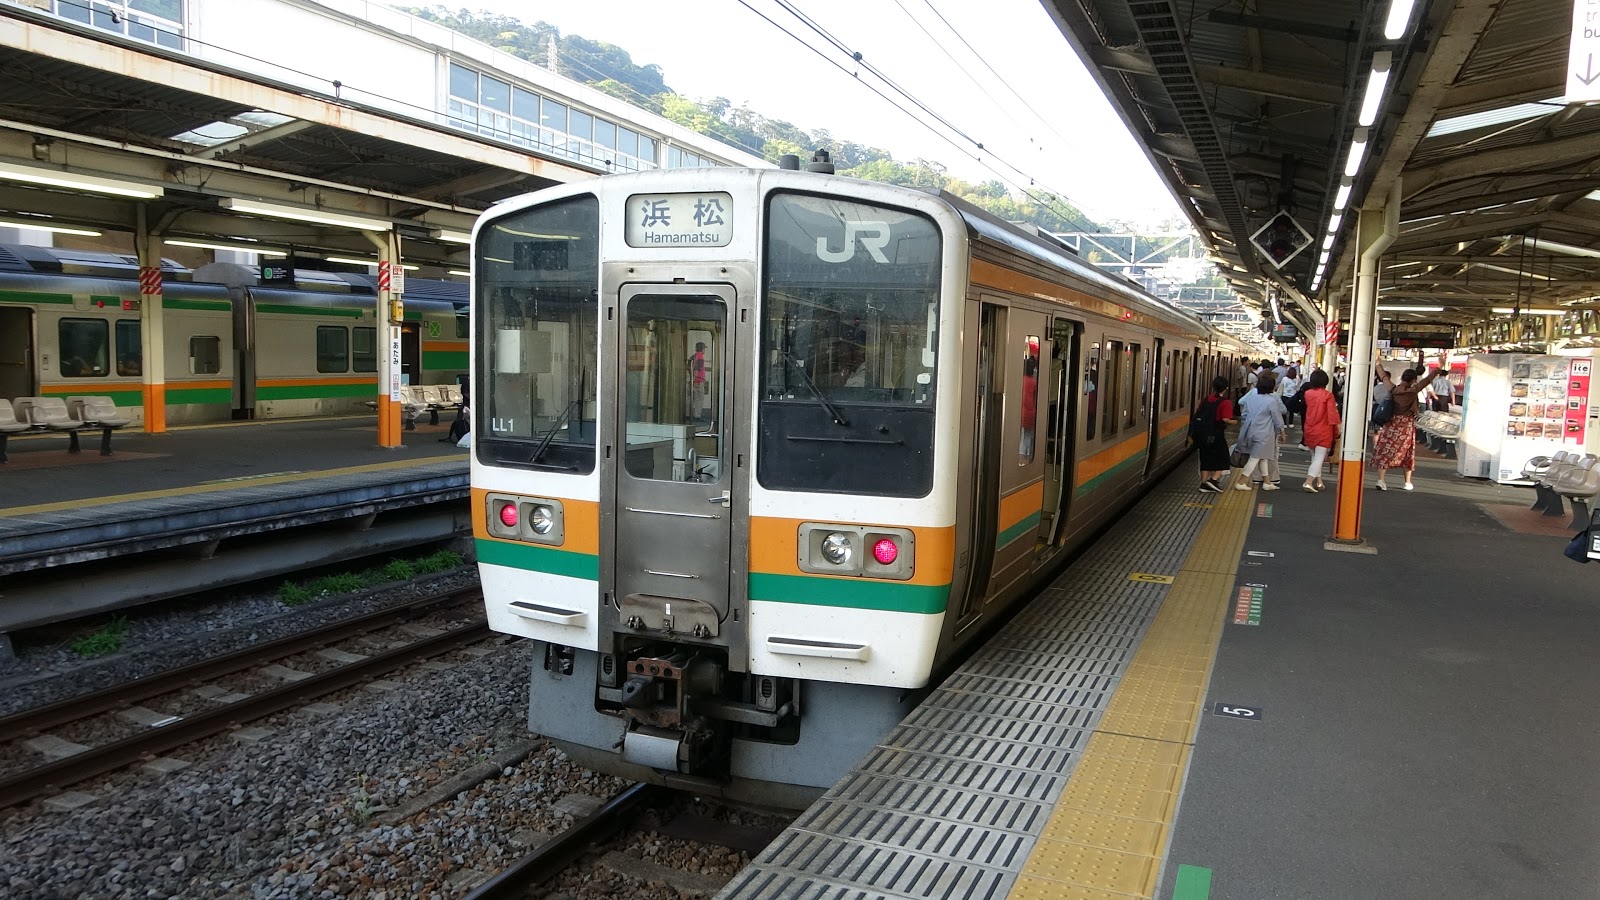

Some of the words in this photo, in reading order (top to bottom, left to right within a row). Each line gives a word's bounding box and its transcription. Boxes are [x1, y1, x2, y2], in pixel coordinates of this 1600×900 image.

[641, 198, 725, 228] 浜松
[644, 231, 720, 244] Hamamatsu
[816, 220, 891, 263] JR
[492, 417, 514, 432] LL1
[1222, 706, 1255, 717] 5
